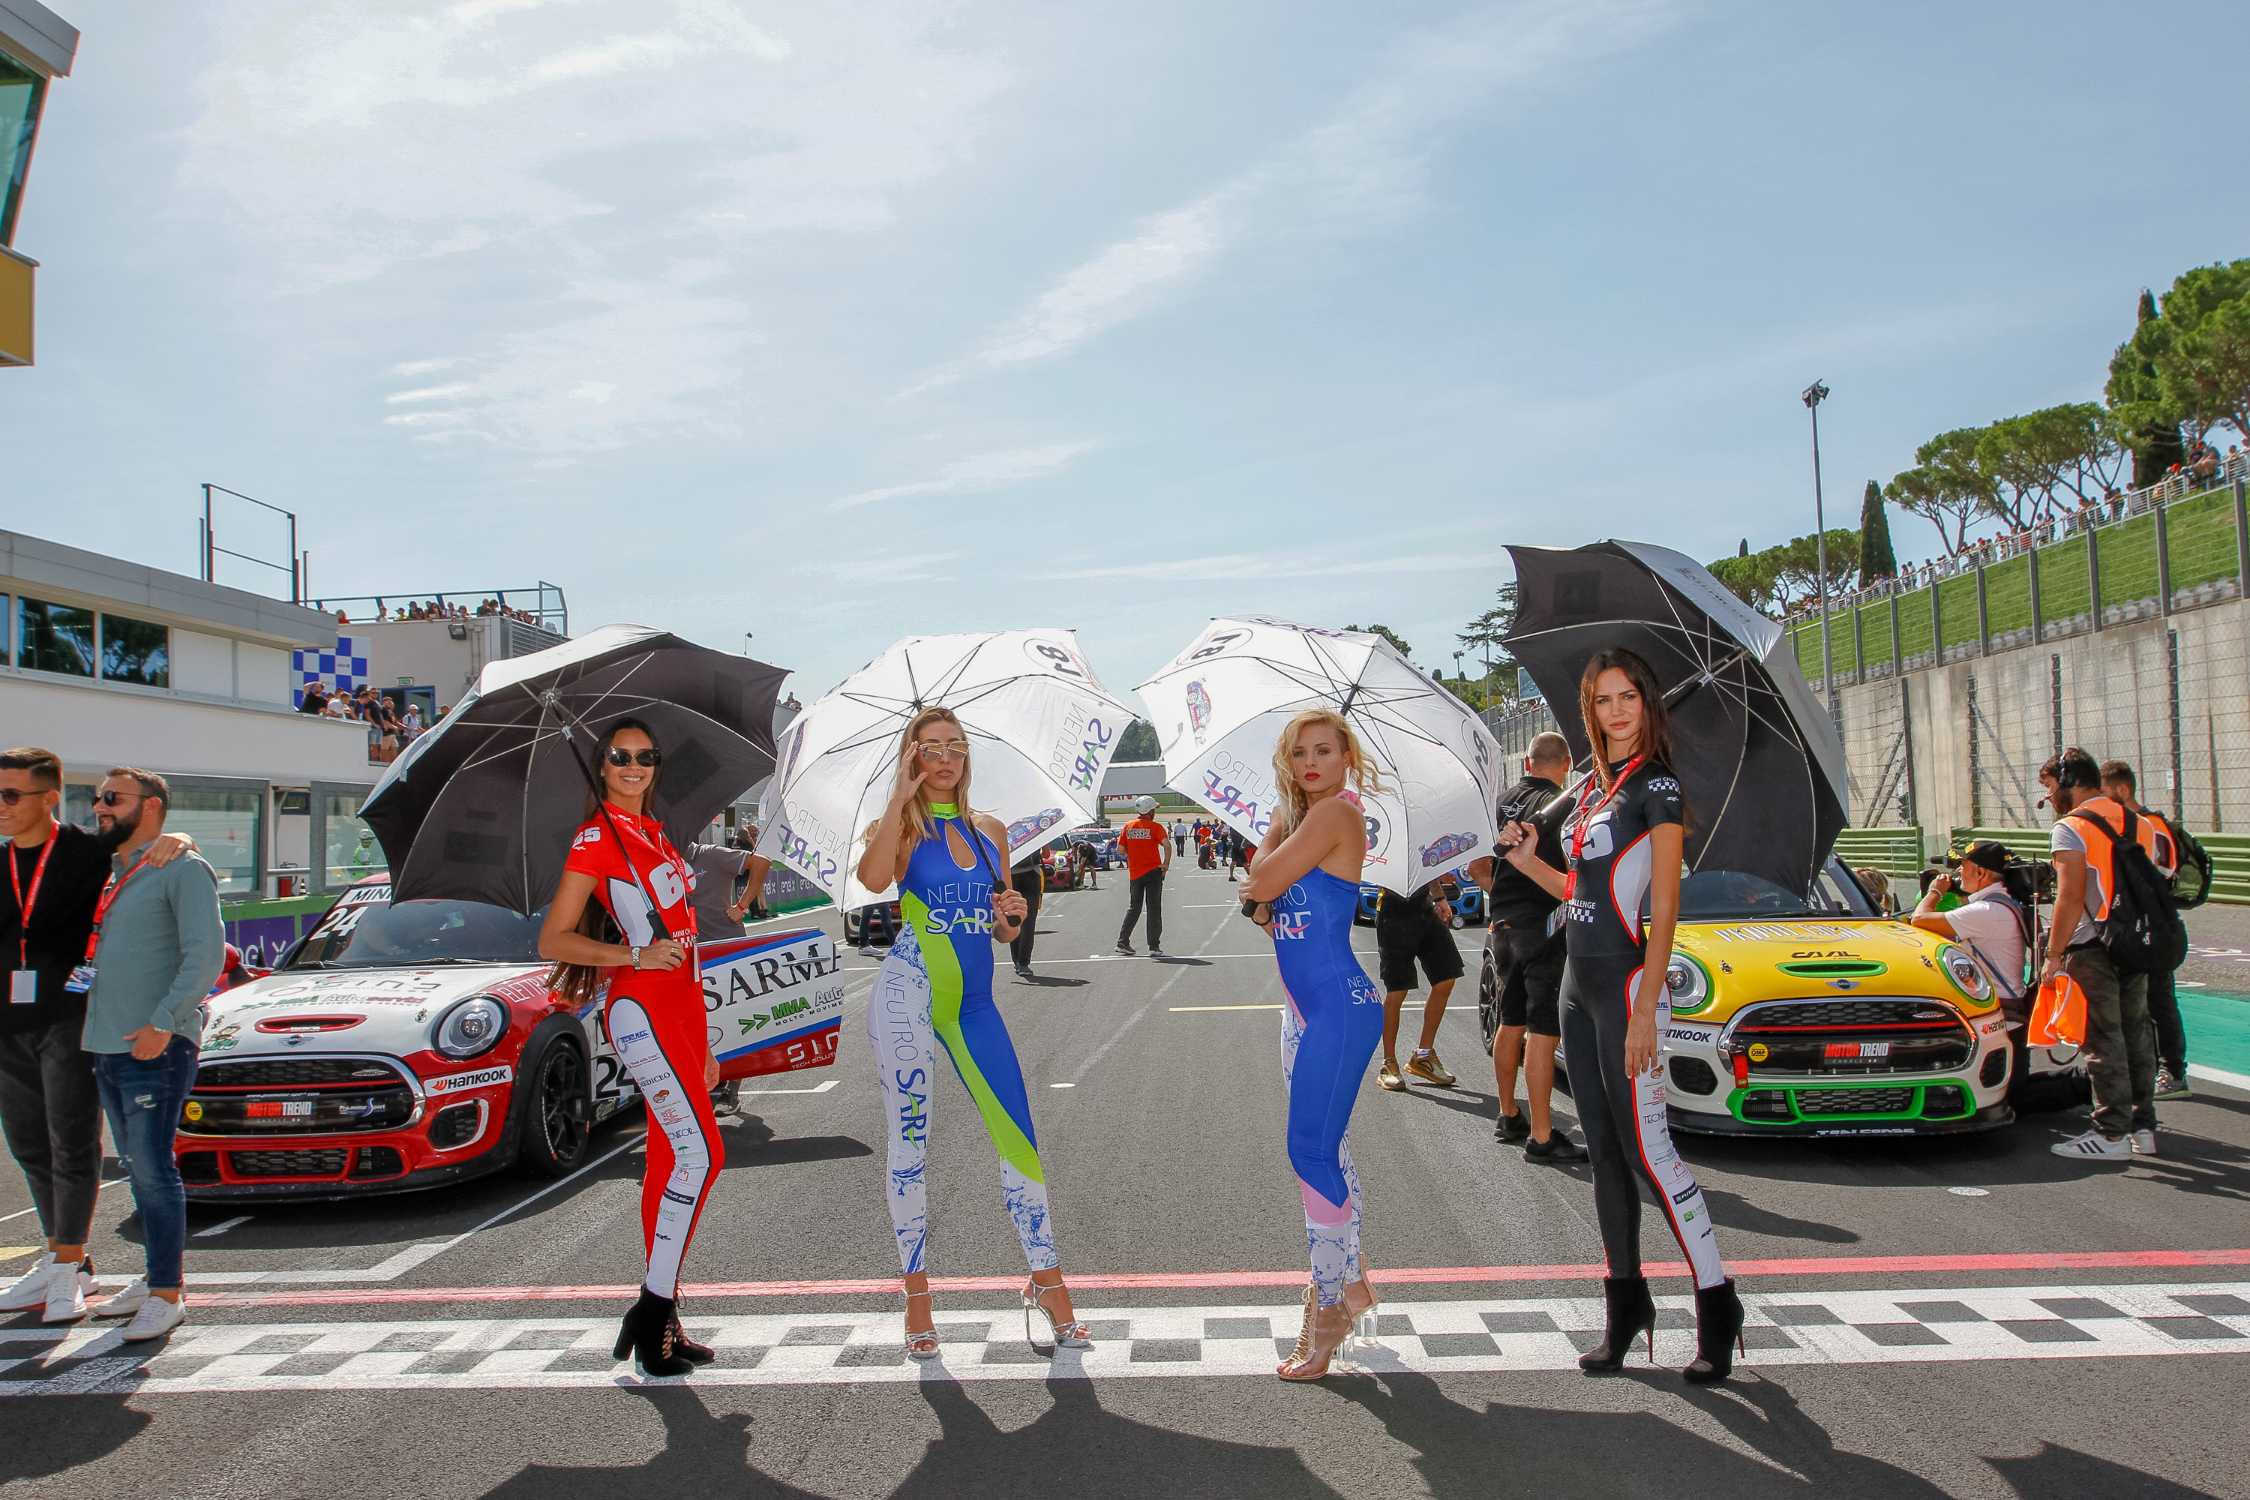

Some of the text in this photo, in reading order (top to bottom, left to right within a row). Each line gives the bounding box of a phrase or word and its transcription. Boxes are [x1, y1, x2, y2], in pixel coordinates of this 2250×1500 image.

[927, 882, 993, 905] NEUTR
[926, 907, 993, 935] SAR
[814, 986, 844, 1007] Aut
[775, 1001, 844, 1027] MOLTO MOVIME
[884, 970, 919, 1062] NEUTRO
[1666, 1028, 1712, 1044] NKOOK
[811, 1052, 836, 1064] SOLUT
